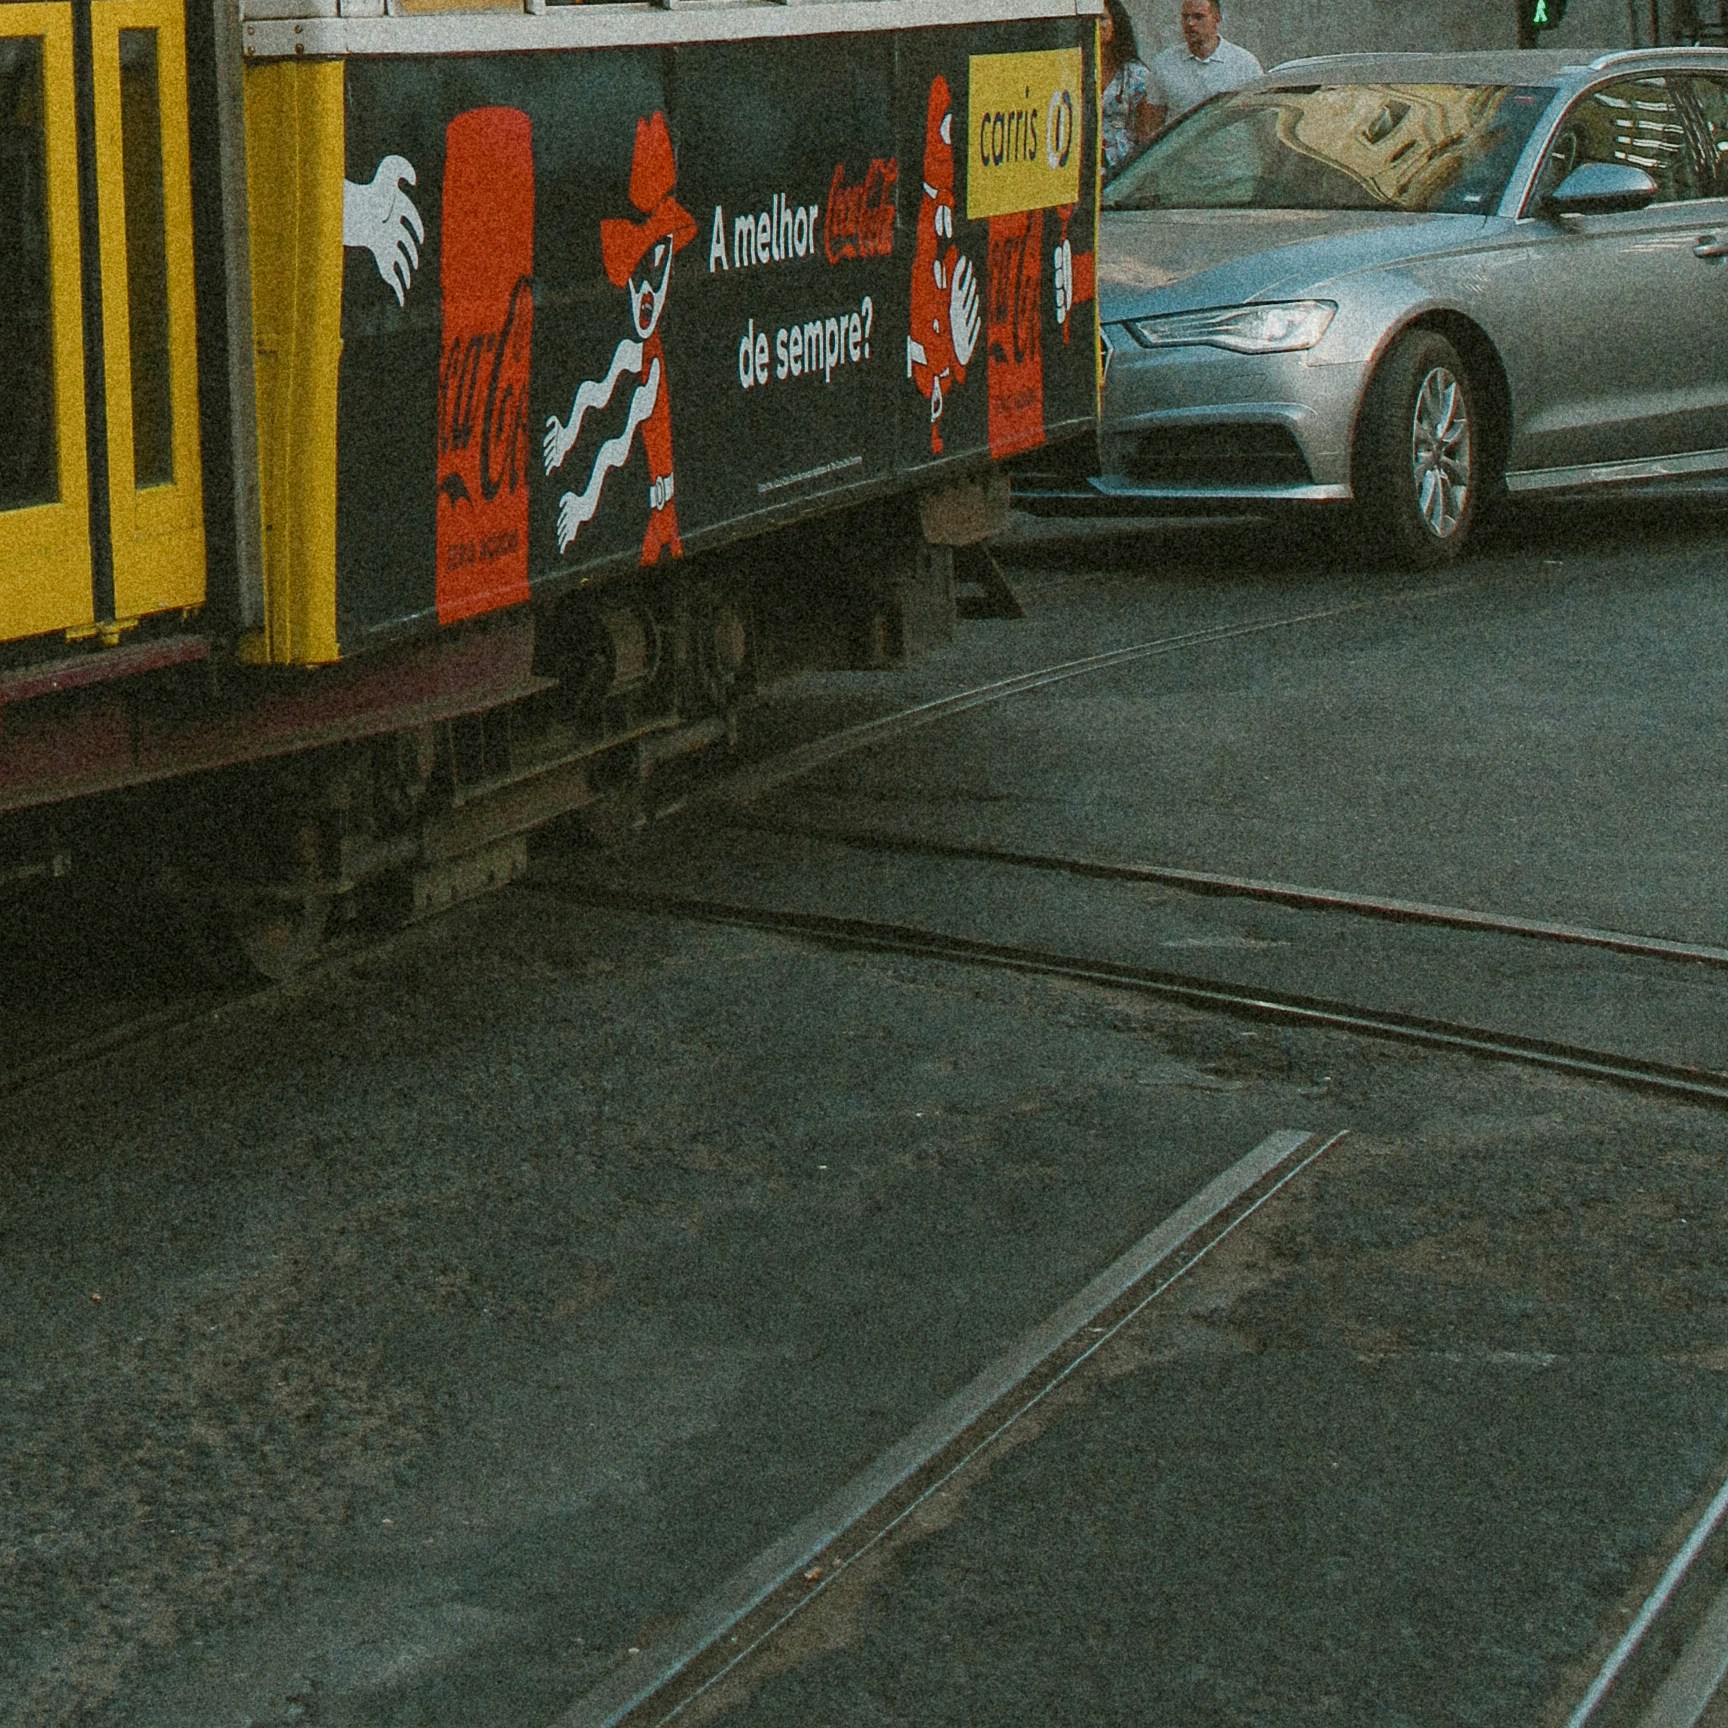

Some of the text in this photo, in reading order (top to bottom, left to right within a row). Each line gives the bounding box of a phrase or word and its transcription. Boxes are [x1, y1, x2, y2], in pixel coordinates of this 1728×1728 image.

[980, 85, 1038, 166] carris
[709, 205, 729, 273] A
[734, 192, 819, 268] melhor
[738, 295, 873, 389] de sempre?
